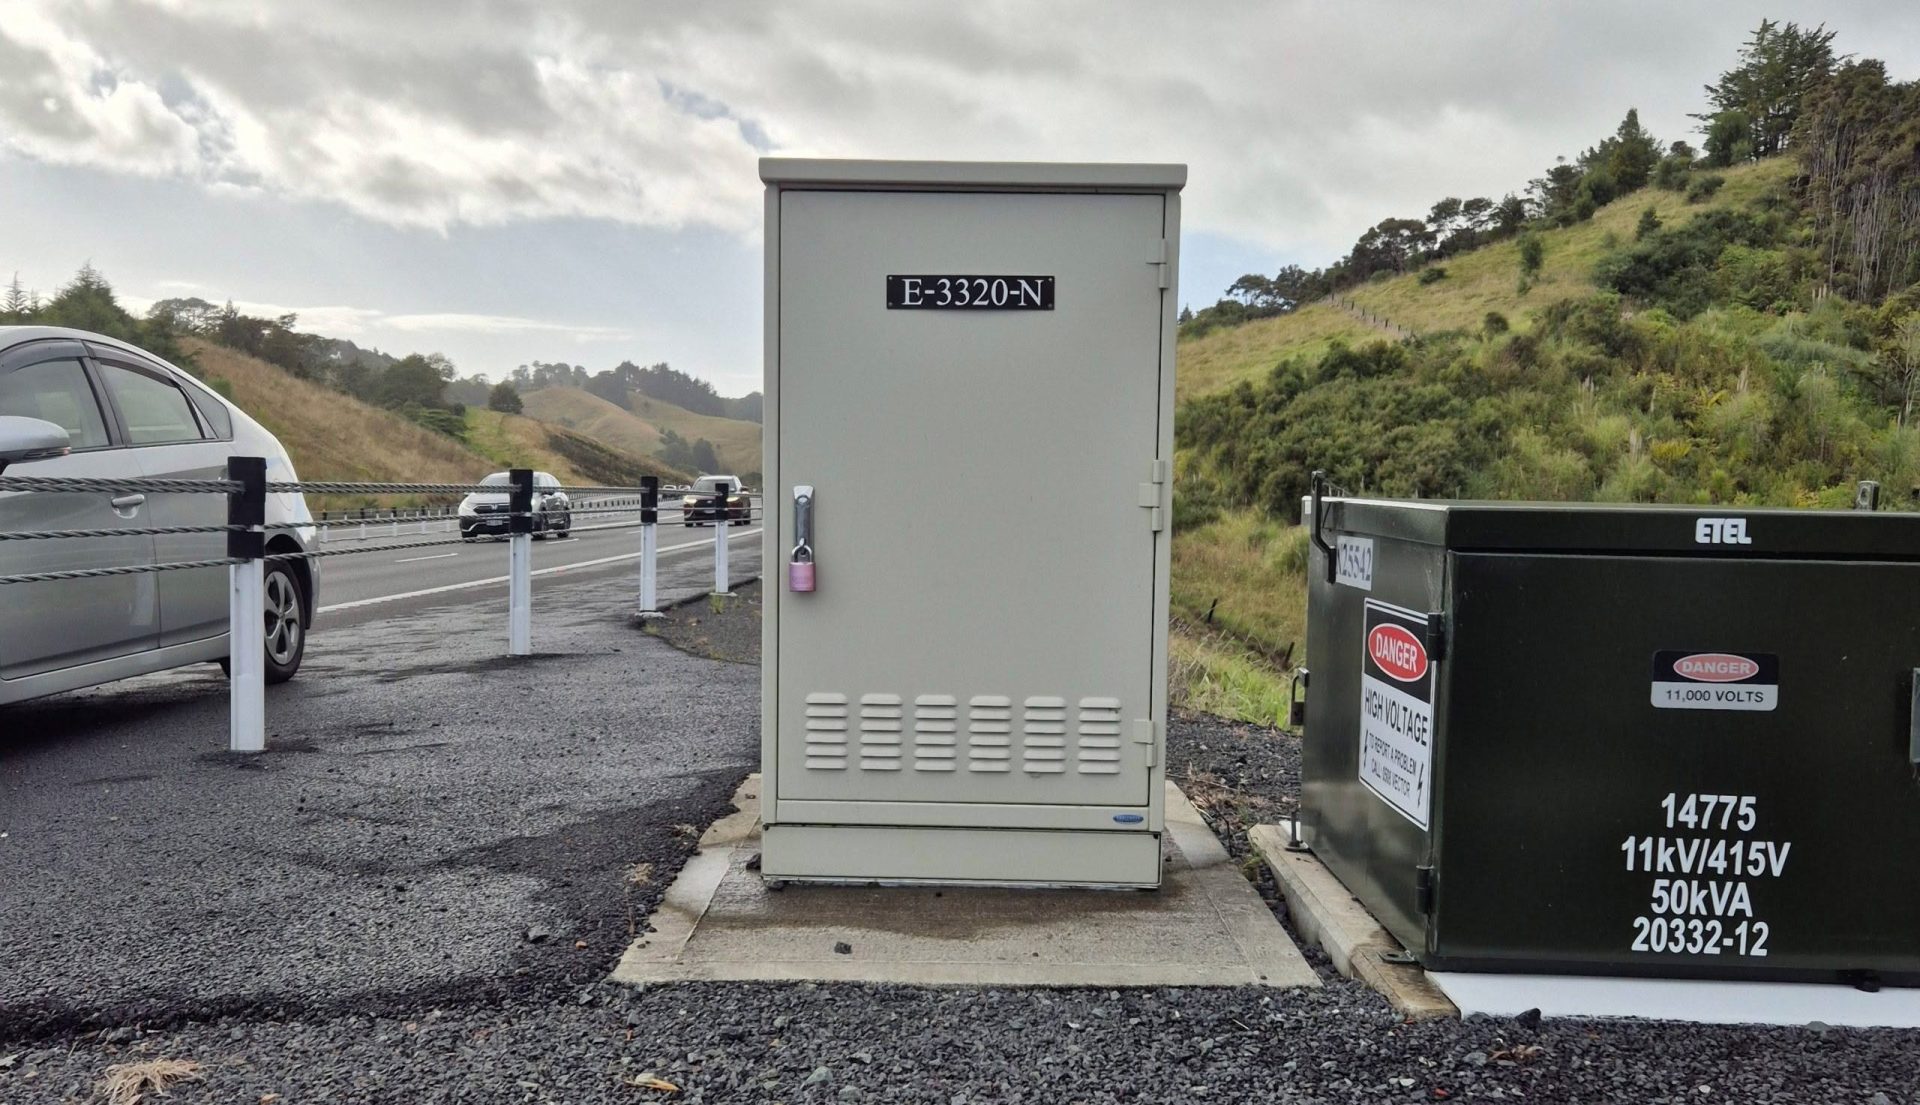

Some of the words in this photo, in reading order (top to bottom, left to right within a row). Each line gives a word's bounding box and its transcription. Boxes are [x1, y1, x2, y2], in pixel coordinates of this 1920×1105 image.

[901, 278, 1044, 306] E-3320-N
[1695, 518, 1752, 544] ETEL
[1376, 633, 1417, 672] DANGER
[1682, 661, 1750, 674] DANGER
[1666, 690, 1711, 702] 11,000
[1716, 691, 1764, 702] VOLTS
[1364, 687, 1383, 722] HIGH
[1385, 699, 1428, 746] VOLTAGE
[1374, 736, 1390, 759] REPORT
[1394, 749, 1416, 775] PROBLEM
[1392, 773, 1410, 797] VECTOR
[1661, 793, 1756, 831] 14775
[1621, 836, 1791, 877] 11kV/415V
[1651, 879, 1753, 917] 50kVA
[1631, 916, 1769, 956] 20332-12
